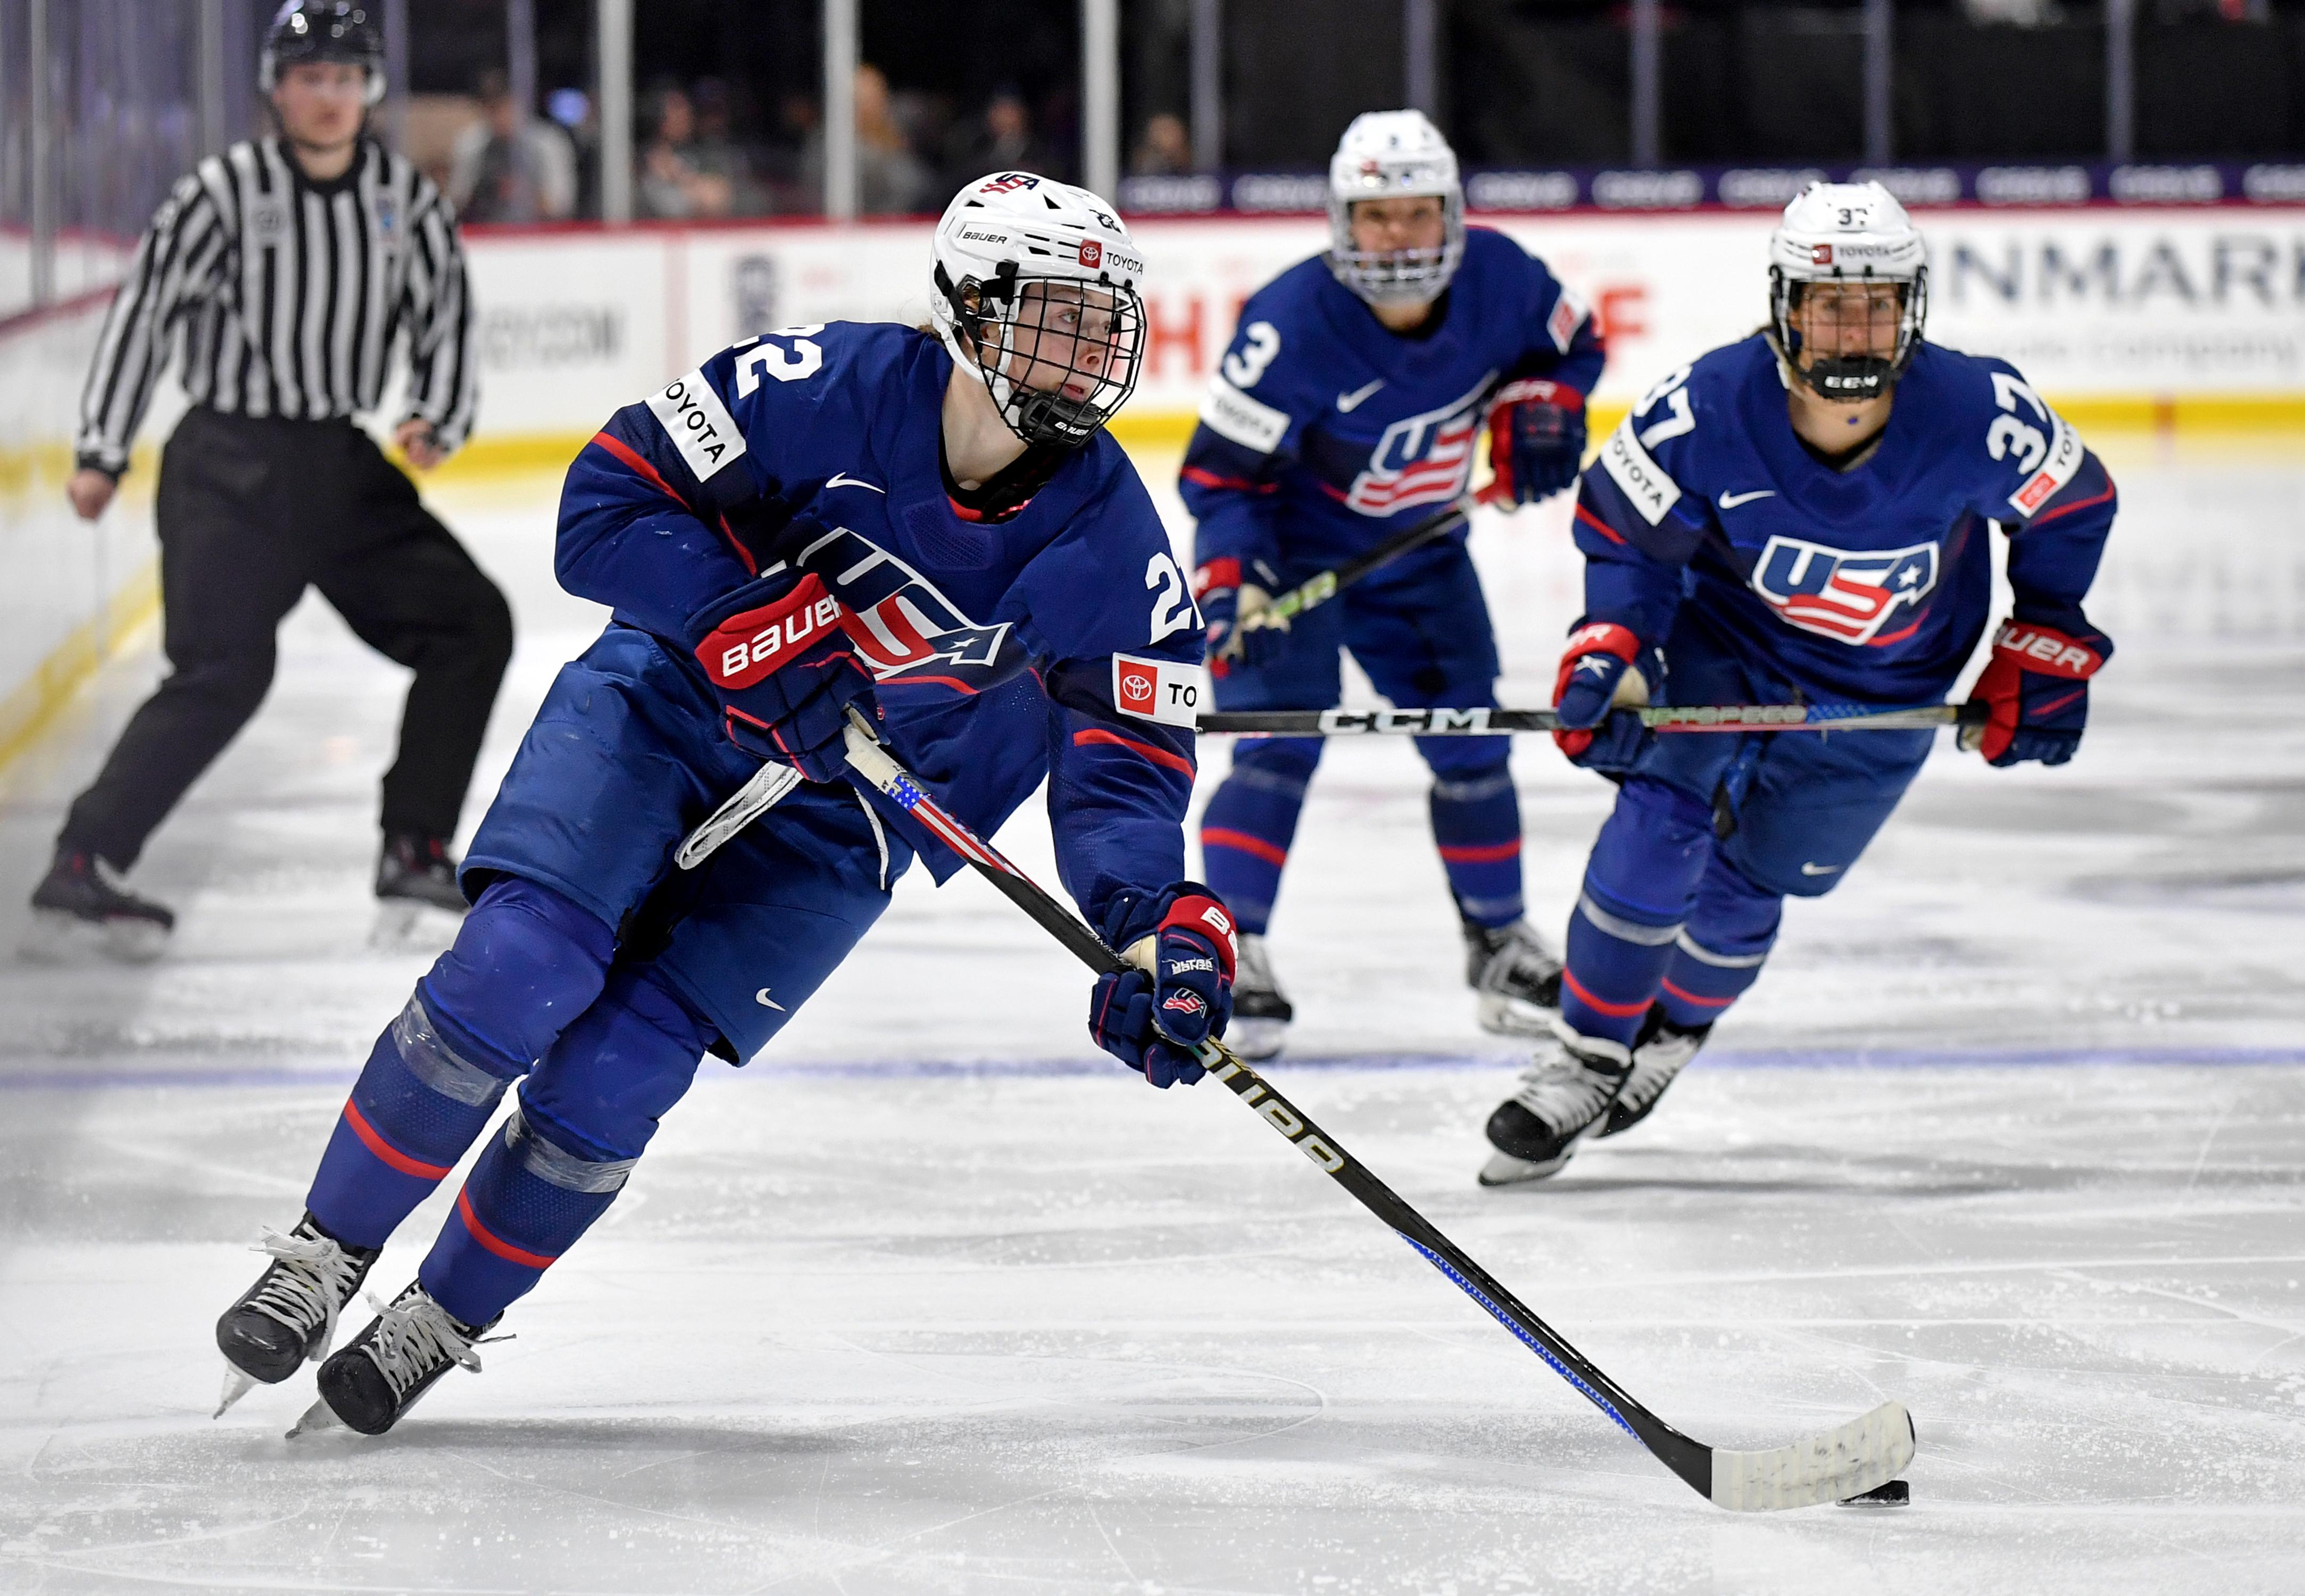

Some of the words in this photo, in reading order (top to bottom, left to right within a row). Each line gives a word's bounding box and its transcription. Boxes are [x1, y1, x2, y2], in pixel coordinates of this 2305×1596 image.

[979, 173, 1040, 194] USA
[1106, 252, 1143, 275] TOYOTA
[733, 323, 826, 400] 2
[1223, 320, 1281, 389] 3
[663, 378, 727, 464] OYOTA
[1986, 371, 2049, 476] 37
[1145, 551, 1206, 645] 2
[1750, 535, 1940, 646] USA
[1318, 706, 1493, 735] CCM
